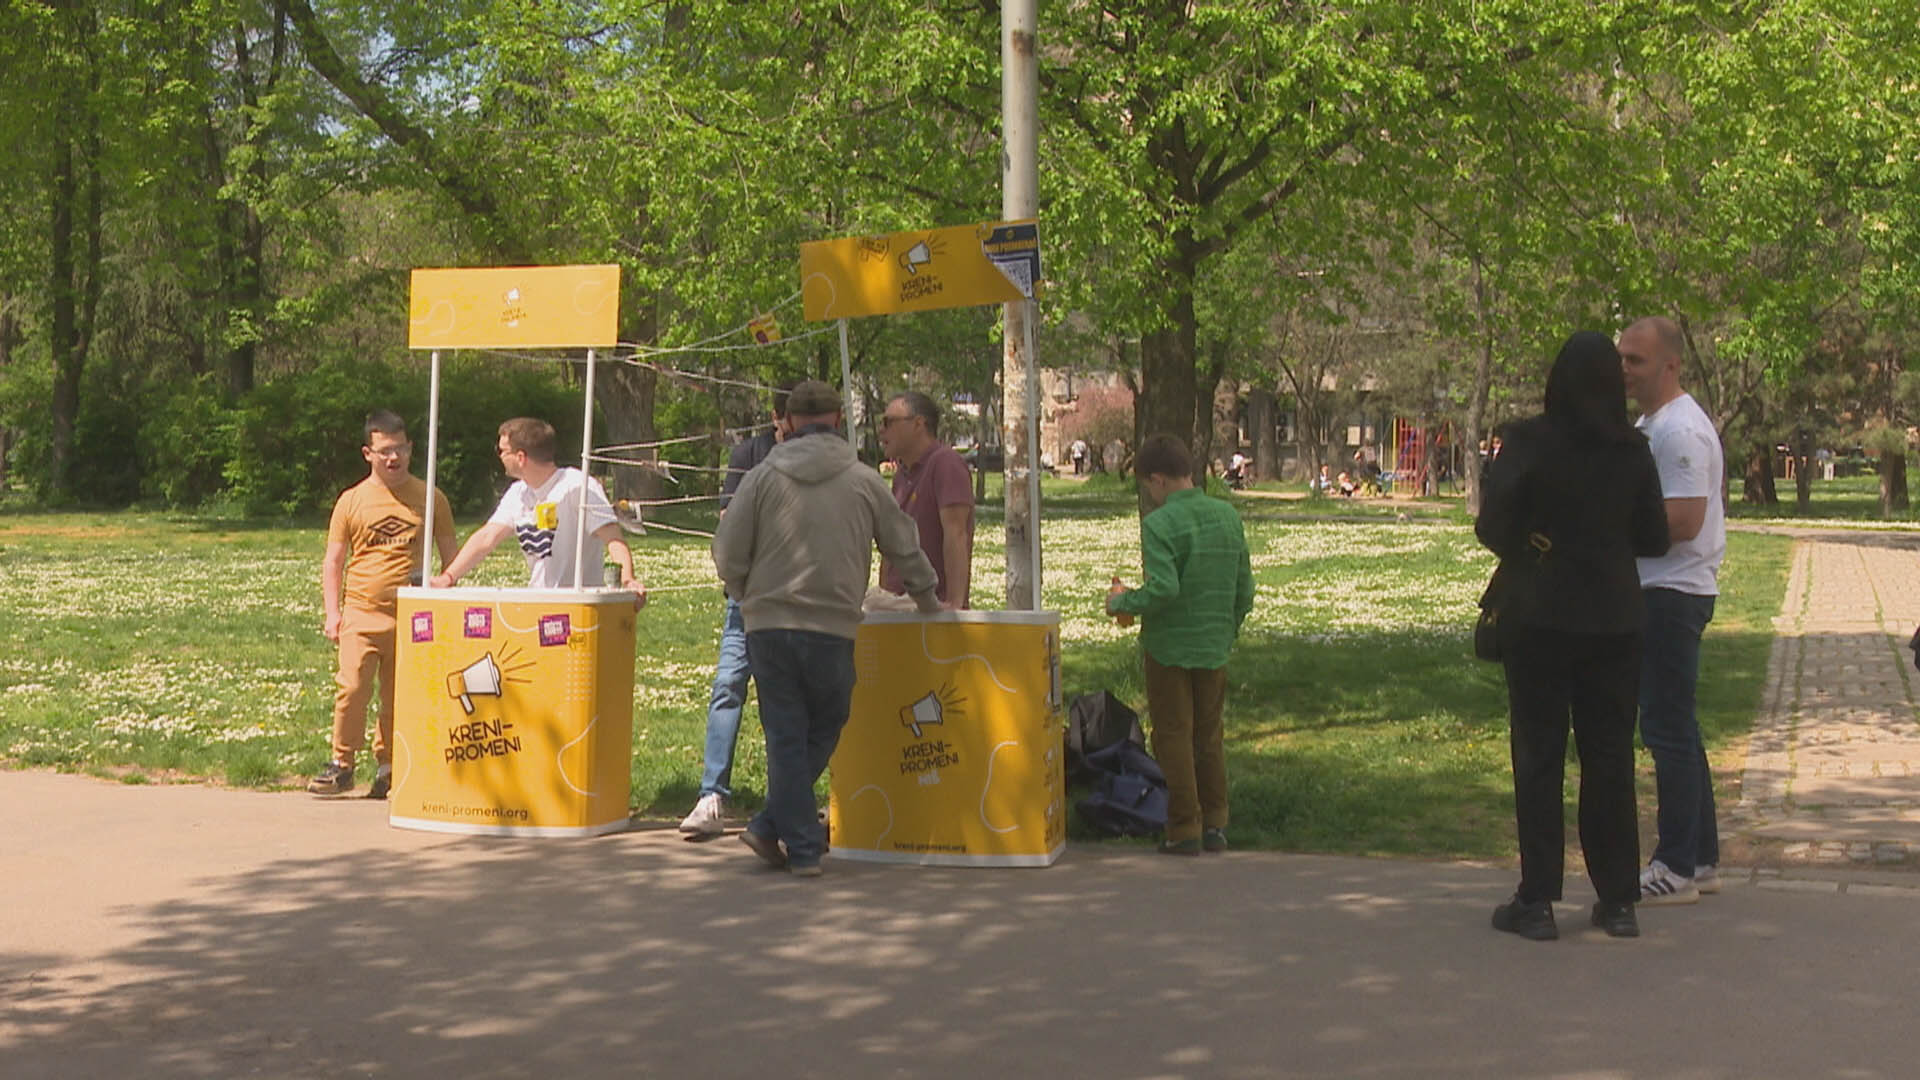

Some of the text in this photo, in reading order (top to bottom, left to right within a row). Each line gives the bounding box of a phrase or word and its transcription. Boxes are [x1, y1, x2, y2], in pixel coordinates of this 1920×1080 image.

[448, 718, 513, 745] KRENI-
[444, 736, 521, 765] PROMENI
[902, 739, 952, 759] KRENI-
[900, 752, 959, 775] PROMENI
[422, 801, 528, 820] kreni-promeni.org
